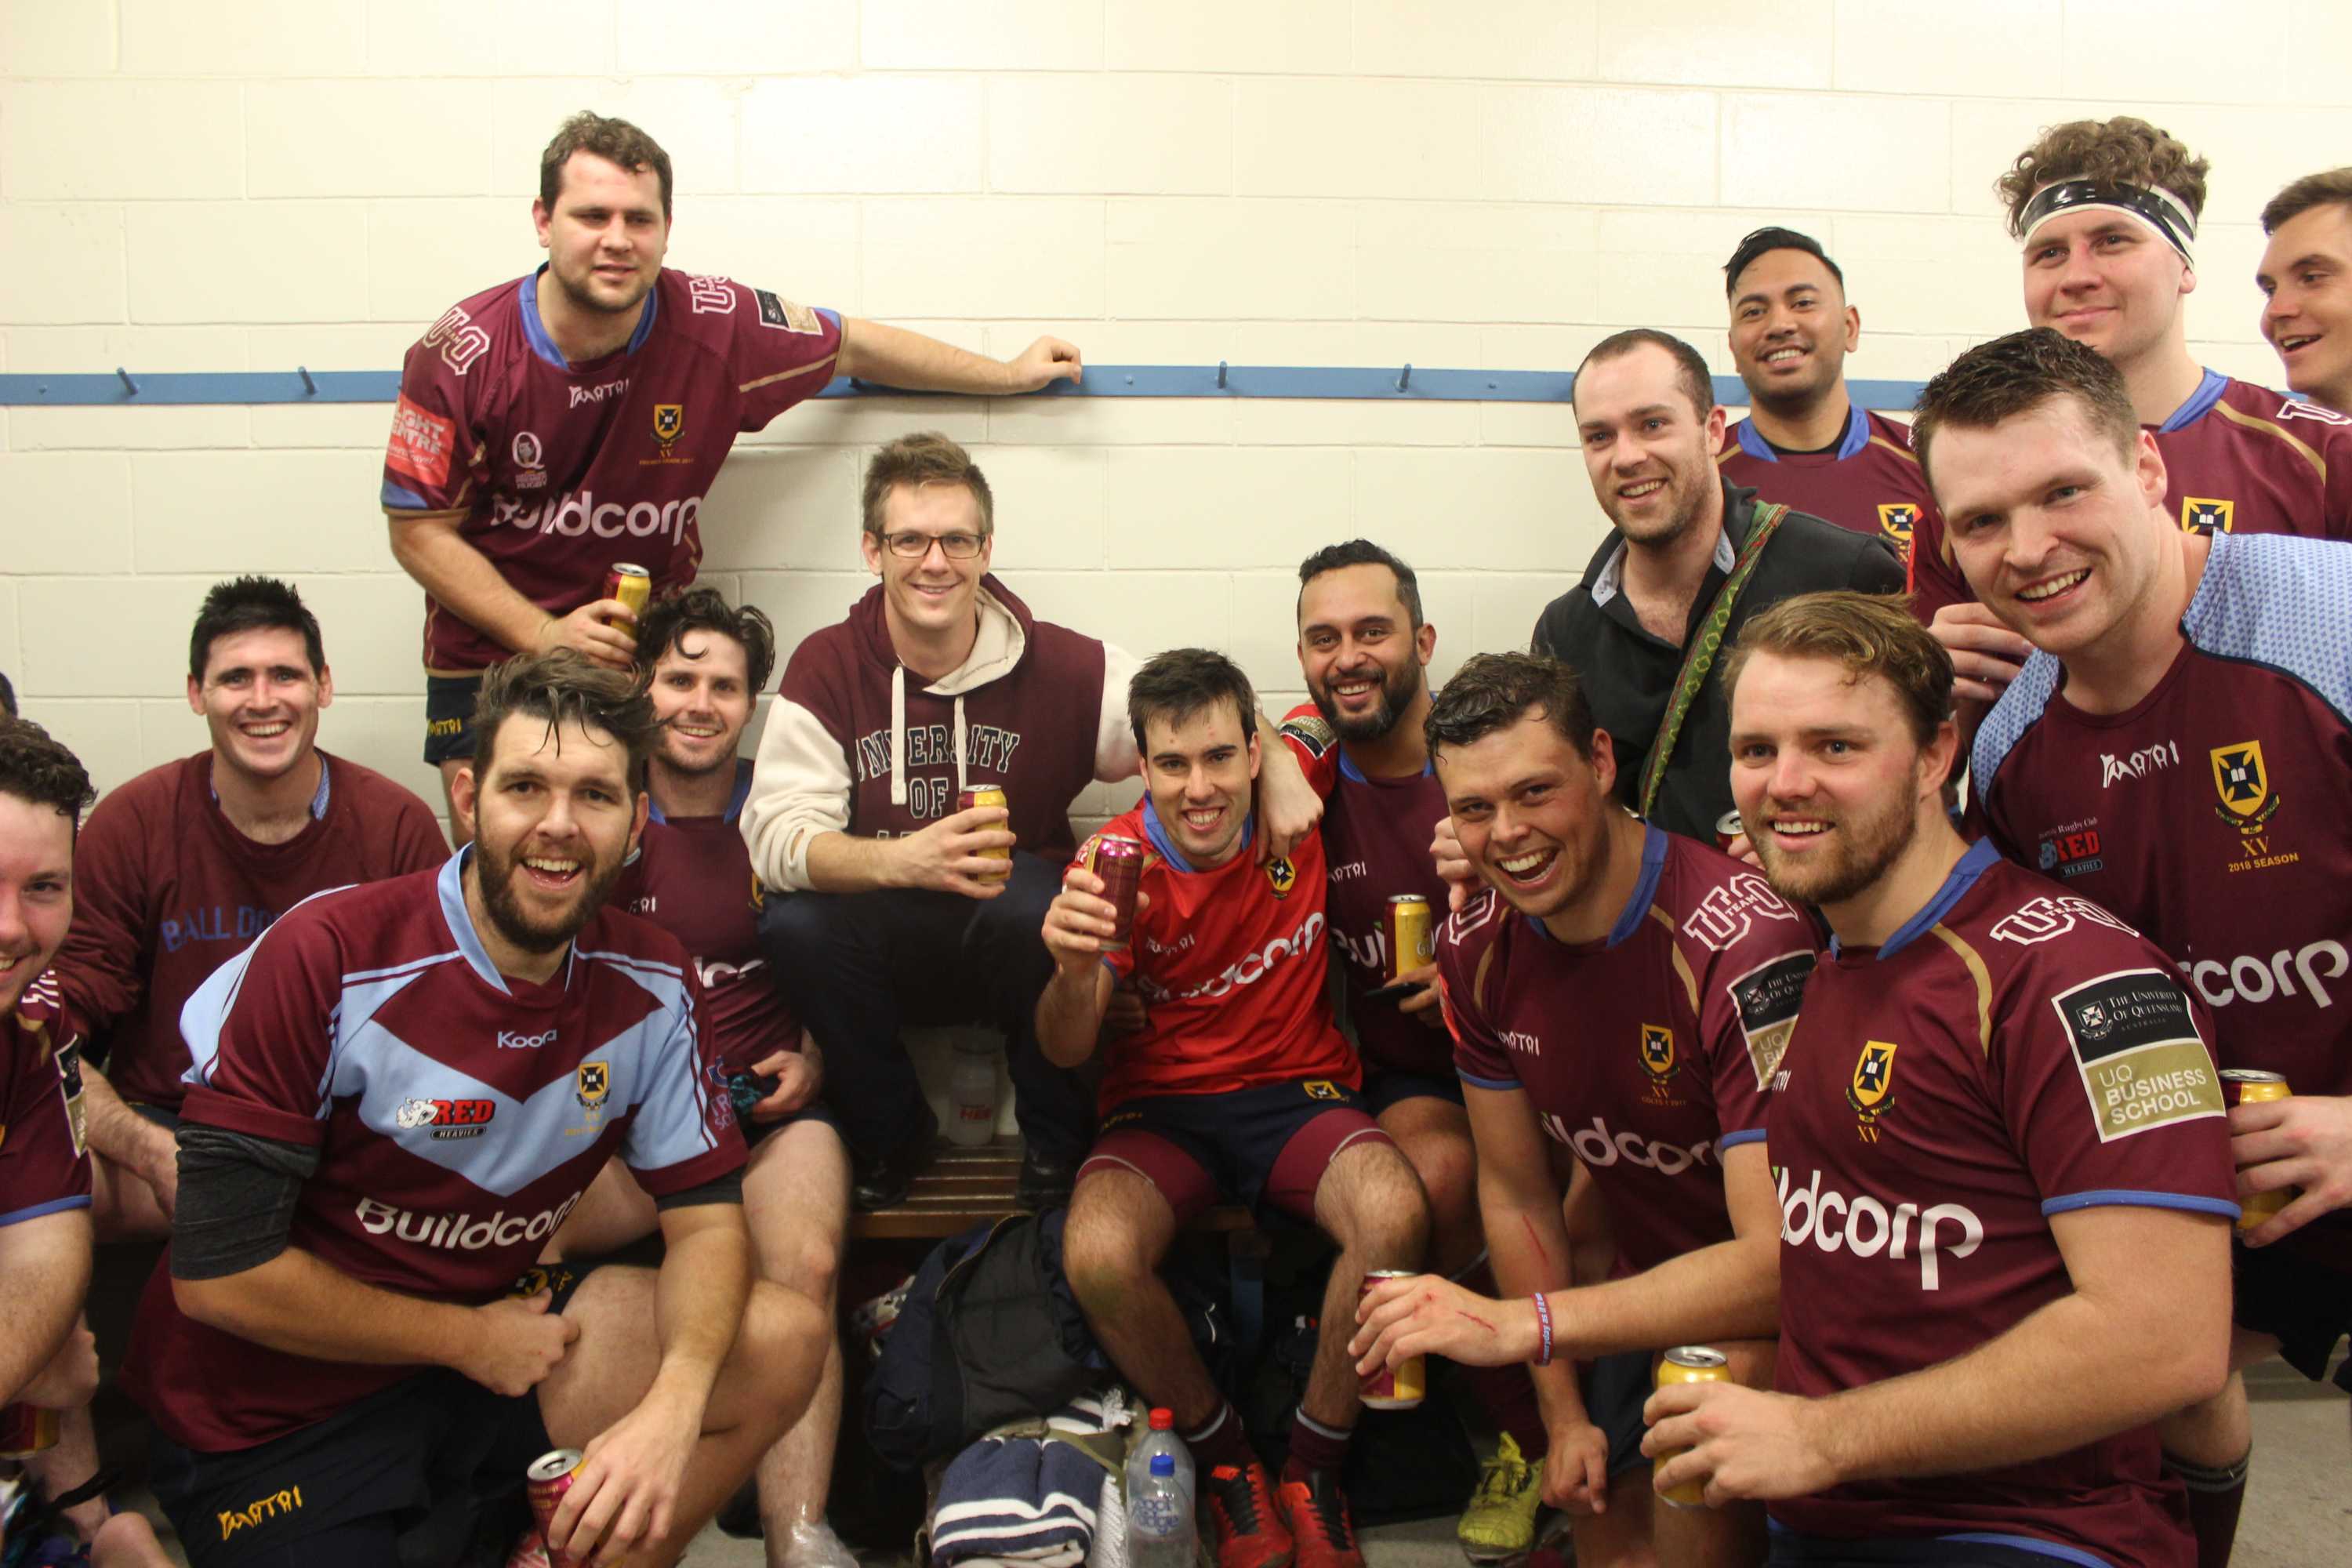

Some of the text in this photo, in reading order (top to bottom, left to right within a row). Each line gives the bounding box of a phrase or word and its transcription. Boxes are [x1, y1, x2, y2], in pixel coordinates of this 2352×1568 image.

[855, 724, 1019, 782] NIERITY
[909, 777, 949, 819] OF
[2055, 830, 2100, 863] RED
[2241, 836, 2269, 858] XV
[2228, 852, 2299, 873] 2018 SEASON
[1725, 894, 1759, 917] TEAM
[162, 906, 232, 953] BALL
[2099, 1064, 2132, 1087] UQ
[2105, 1067, 2207, 1108] BUSINESS
[430, 1099, 495, 1125] RED
[2110, 1090, 2201, 1125] SCHOOL
[1857, 1125, 1880, 1144] XV
